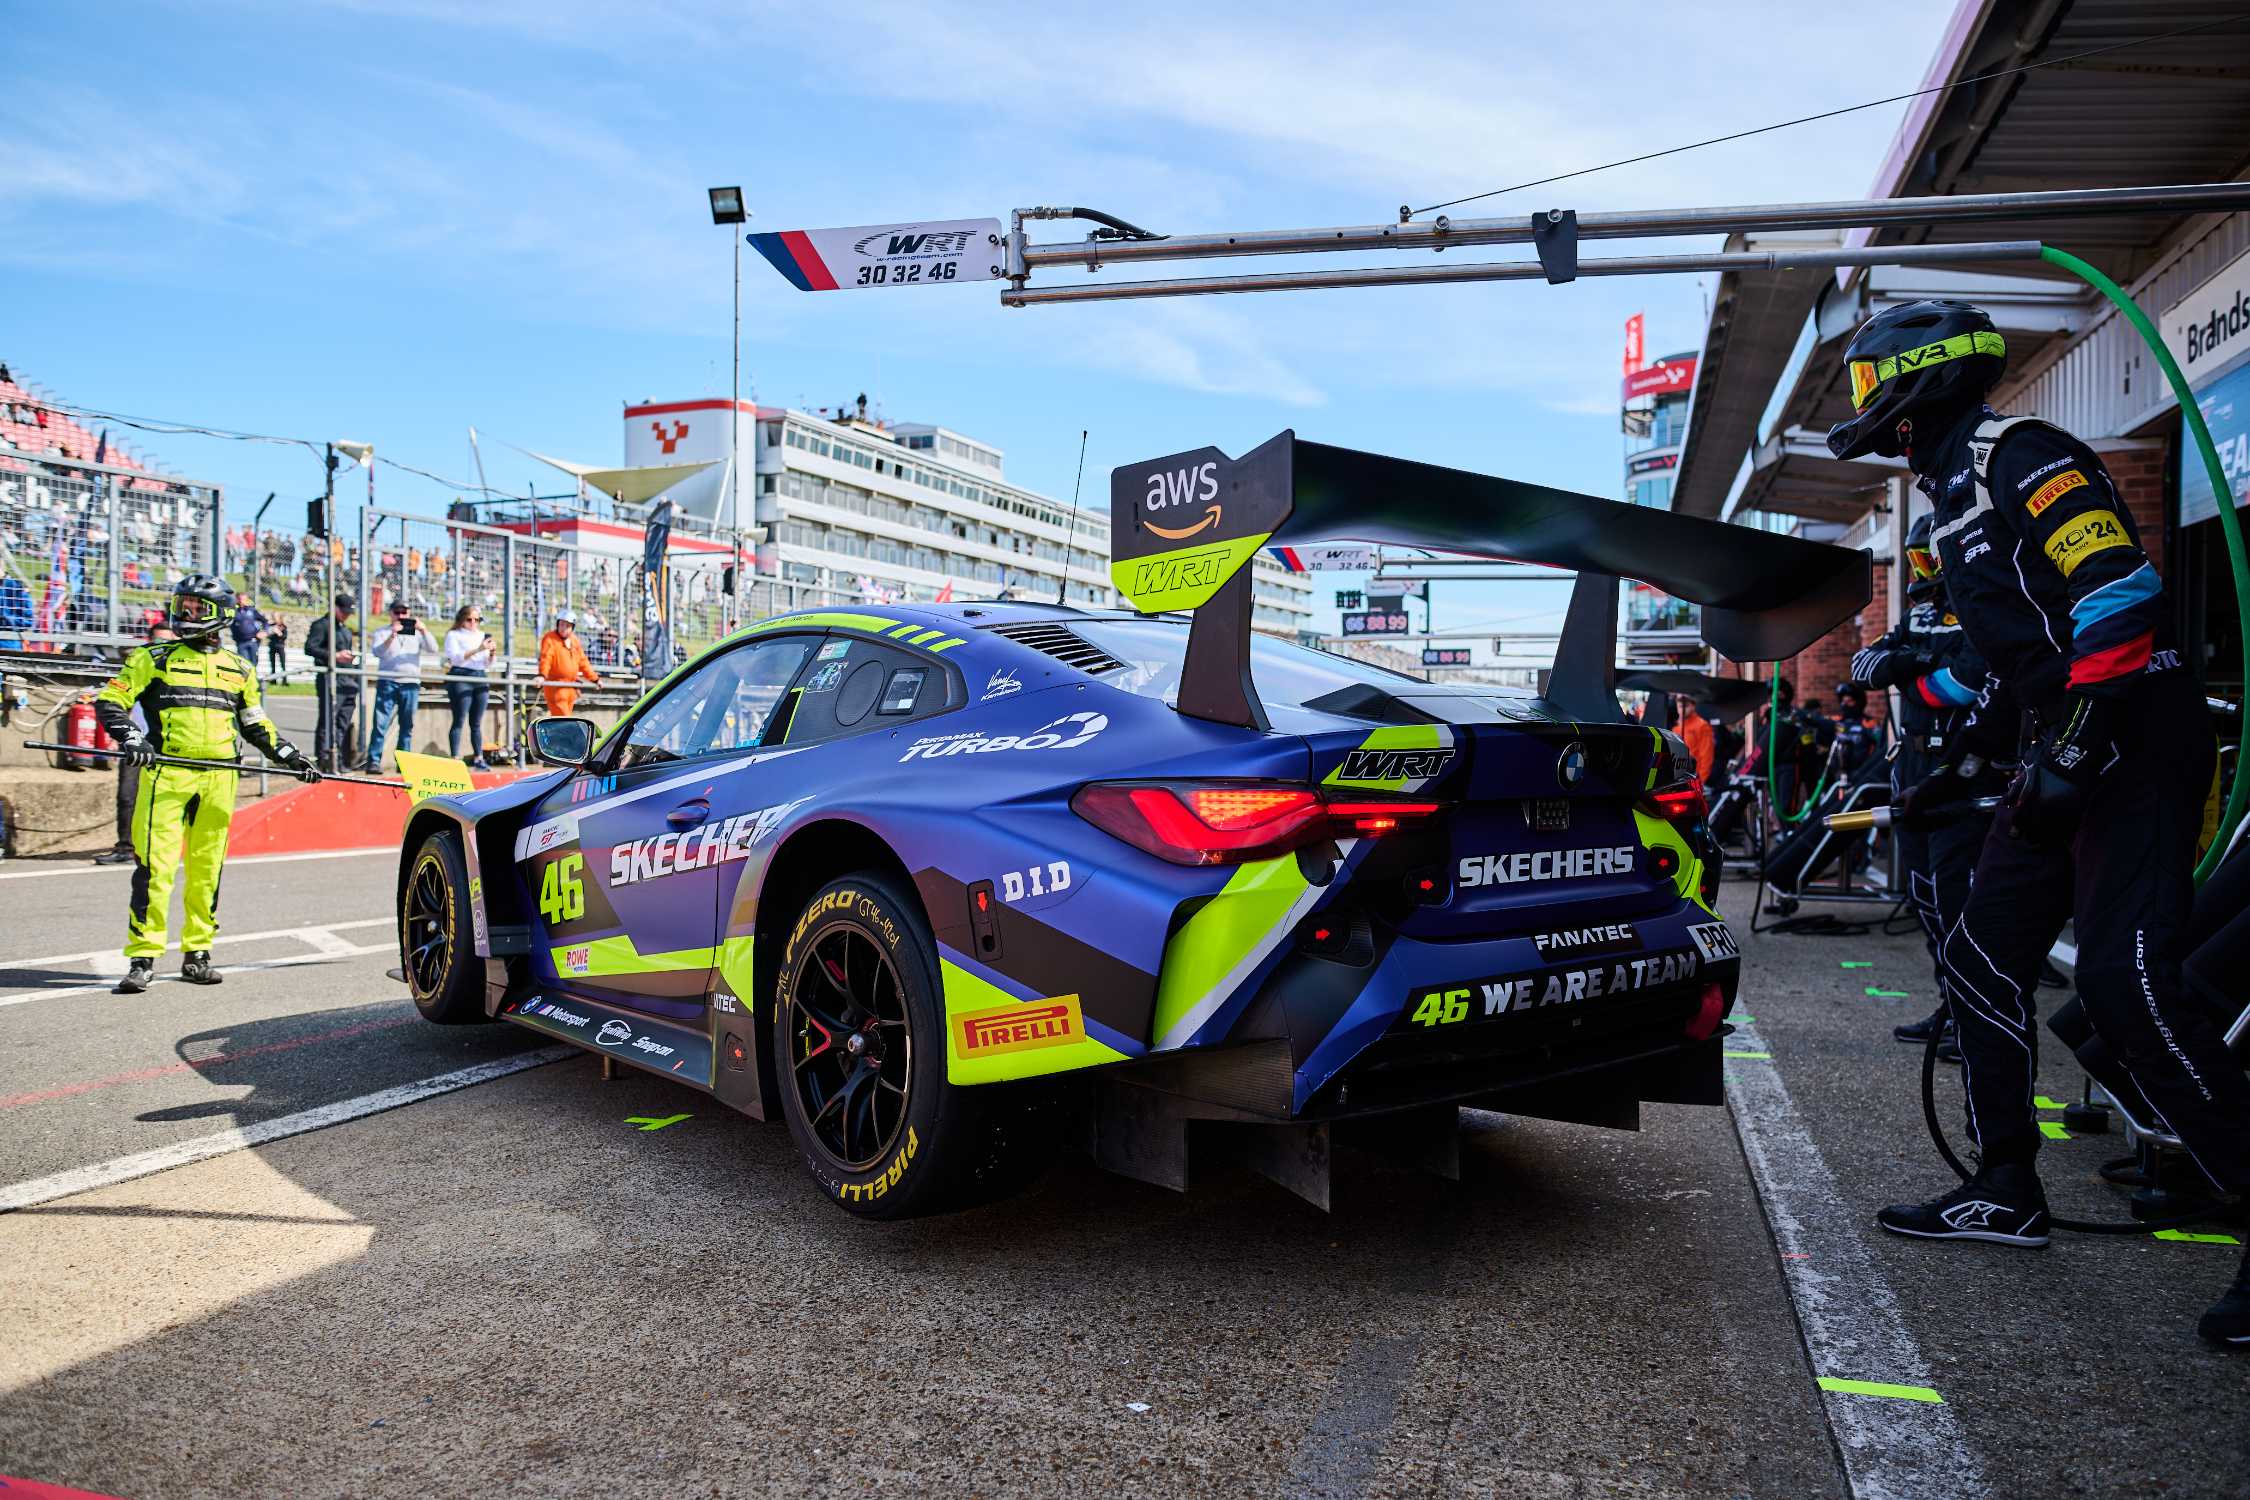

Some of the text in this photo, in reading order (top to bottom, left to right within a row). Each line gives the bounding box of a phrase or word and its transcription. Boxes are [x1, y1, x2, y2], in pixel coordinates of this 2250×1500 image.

[887, 230, 977, 255] WRT
[857, 261, 957, 285] 30 32 46
[2187, 290, 2250, 364] Brands
[1146, 462, 1219, 511] aws
[2017, 455, 2075, 491] SKECHERS
[2031, 472, 2082, 512] PIRELLI
[1133, 548, 1231, 597] WRT
[1309, 562, 1322, 571] 30
[1355, 562, 1368, 570] 46
[1388, 615, 1408, 630] 99
[898, 734, 1062, 763] TURBO
[914, 731, 987, 746] PERTAMAX
[1340, 748, 1457, 779] WRT
[422, 778, 466, 791] START
[1002, 860, 1072, 902] D.I.D
[1459, 846, 1634, 888] SKECHERS
[540, 852, 584, 925] 46
[1534, 923, 1632, 950] FANATEC
[1696, 923, 1740, 958] PRO
[566, 948, 588, 967] ROWE
[1411, 989, 1471, 1026] 46
[1481, 980, 1533, 1015] WE
[1539, 968, 1604, 1007] ARE
[1630, 951, 1697, 990] TEAM
[549, 1007, 591, 1027] Motorsport
[964, 1005, 1069, 1049] PIRELLI
[840, 1125, 918, 1202] PIRELLI
